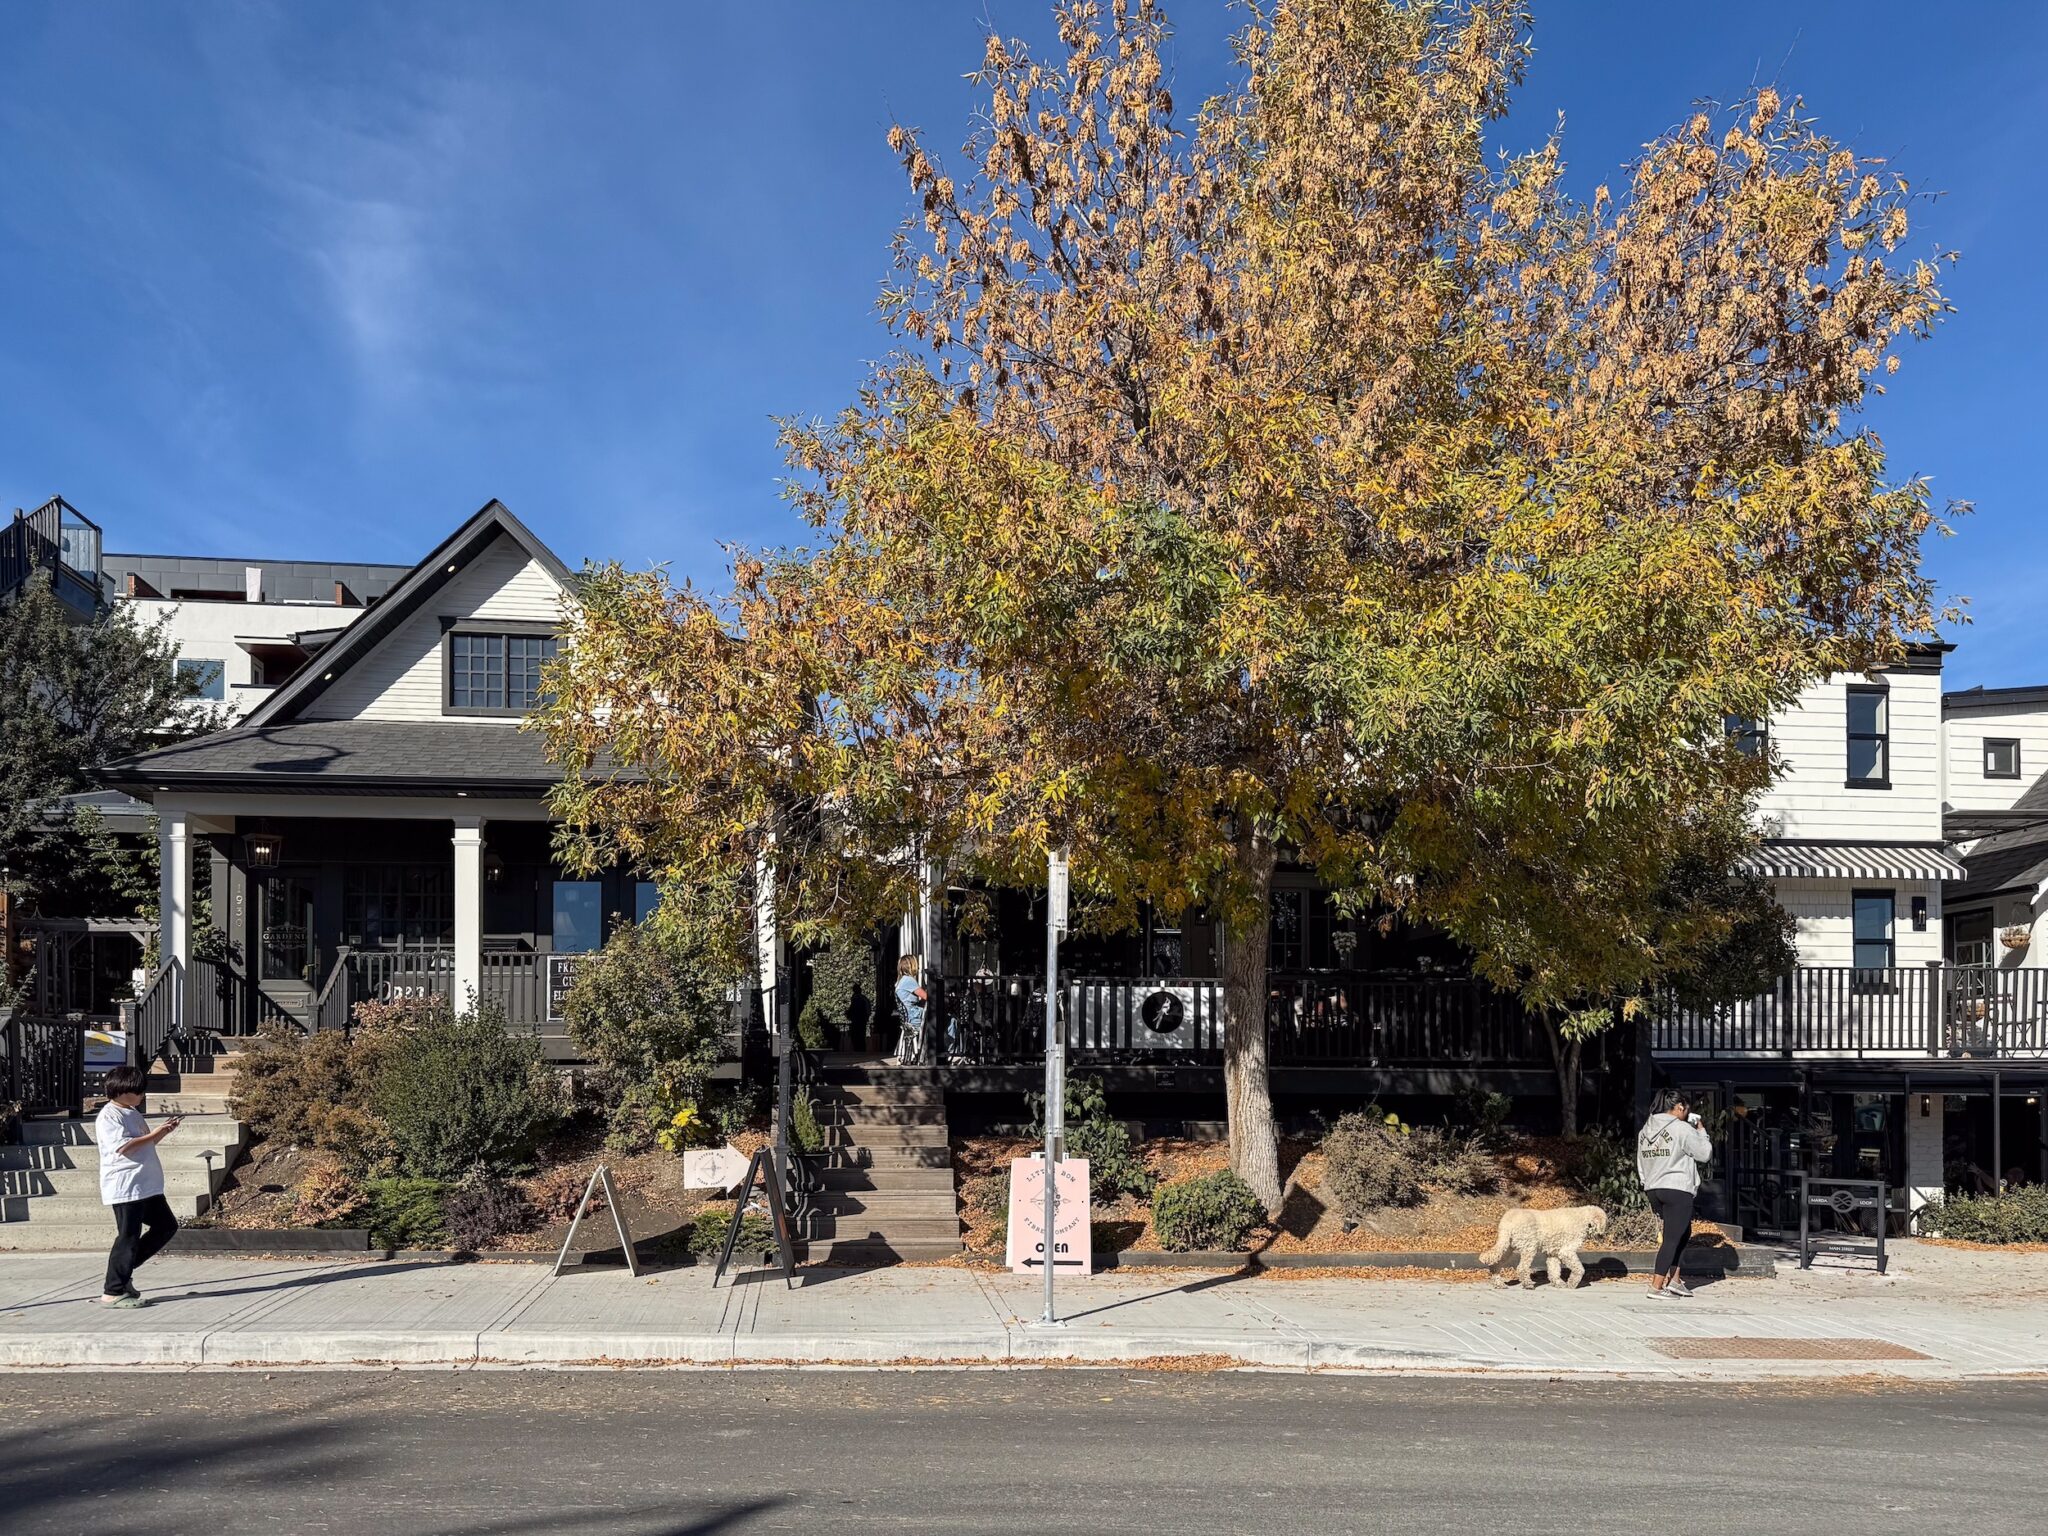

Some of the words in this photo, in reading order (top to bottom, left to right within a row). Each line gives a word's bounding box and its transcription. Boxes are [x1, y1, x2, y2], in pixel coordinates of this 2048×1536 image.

[262, 933, 306, 941] GARDENI
[1061, 1170, 1076, 1182] BOW
[1024, 1217, 1045, 1234] FIBRE
[1054, 1217, 1080, 1235] OMPANY
[1035, 1243, 1069, 1253] OEN
